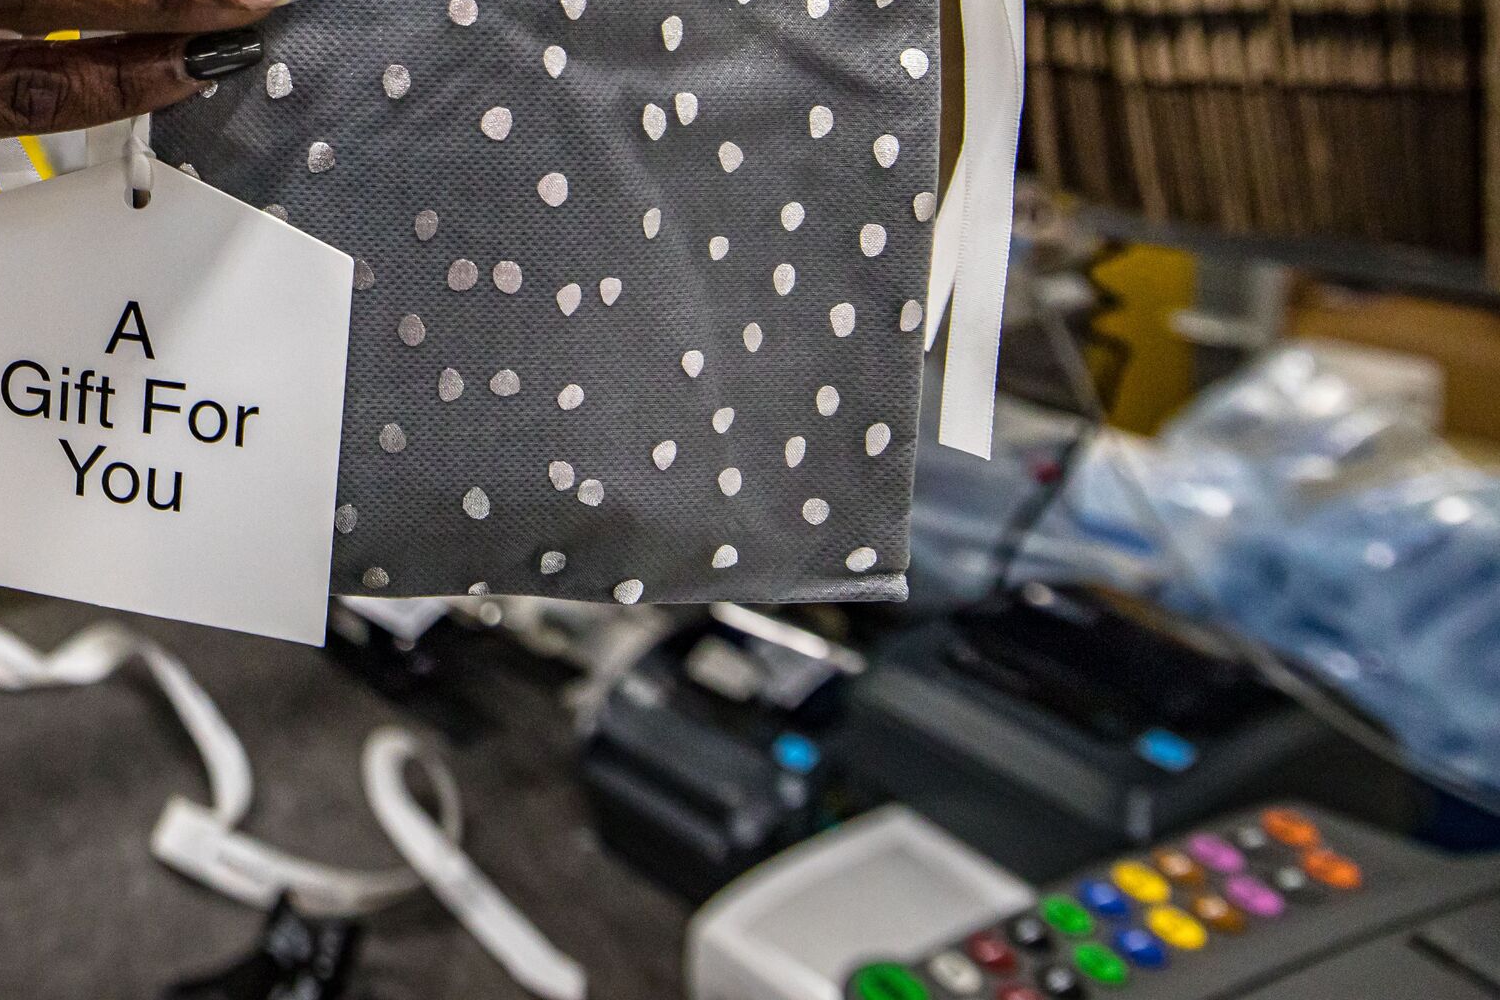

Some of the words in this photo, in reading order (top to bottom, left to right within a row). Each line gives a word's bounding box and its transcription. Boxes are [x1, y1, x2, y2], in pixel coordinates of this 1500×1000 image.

[104, 300, 156, 360] A
[0, 359, 116, 429] Gift
[142, 378, 260, 448] For
[58, 438, 183, 513] You
